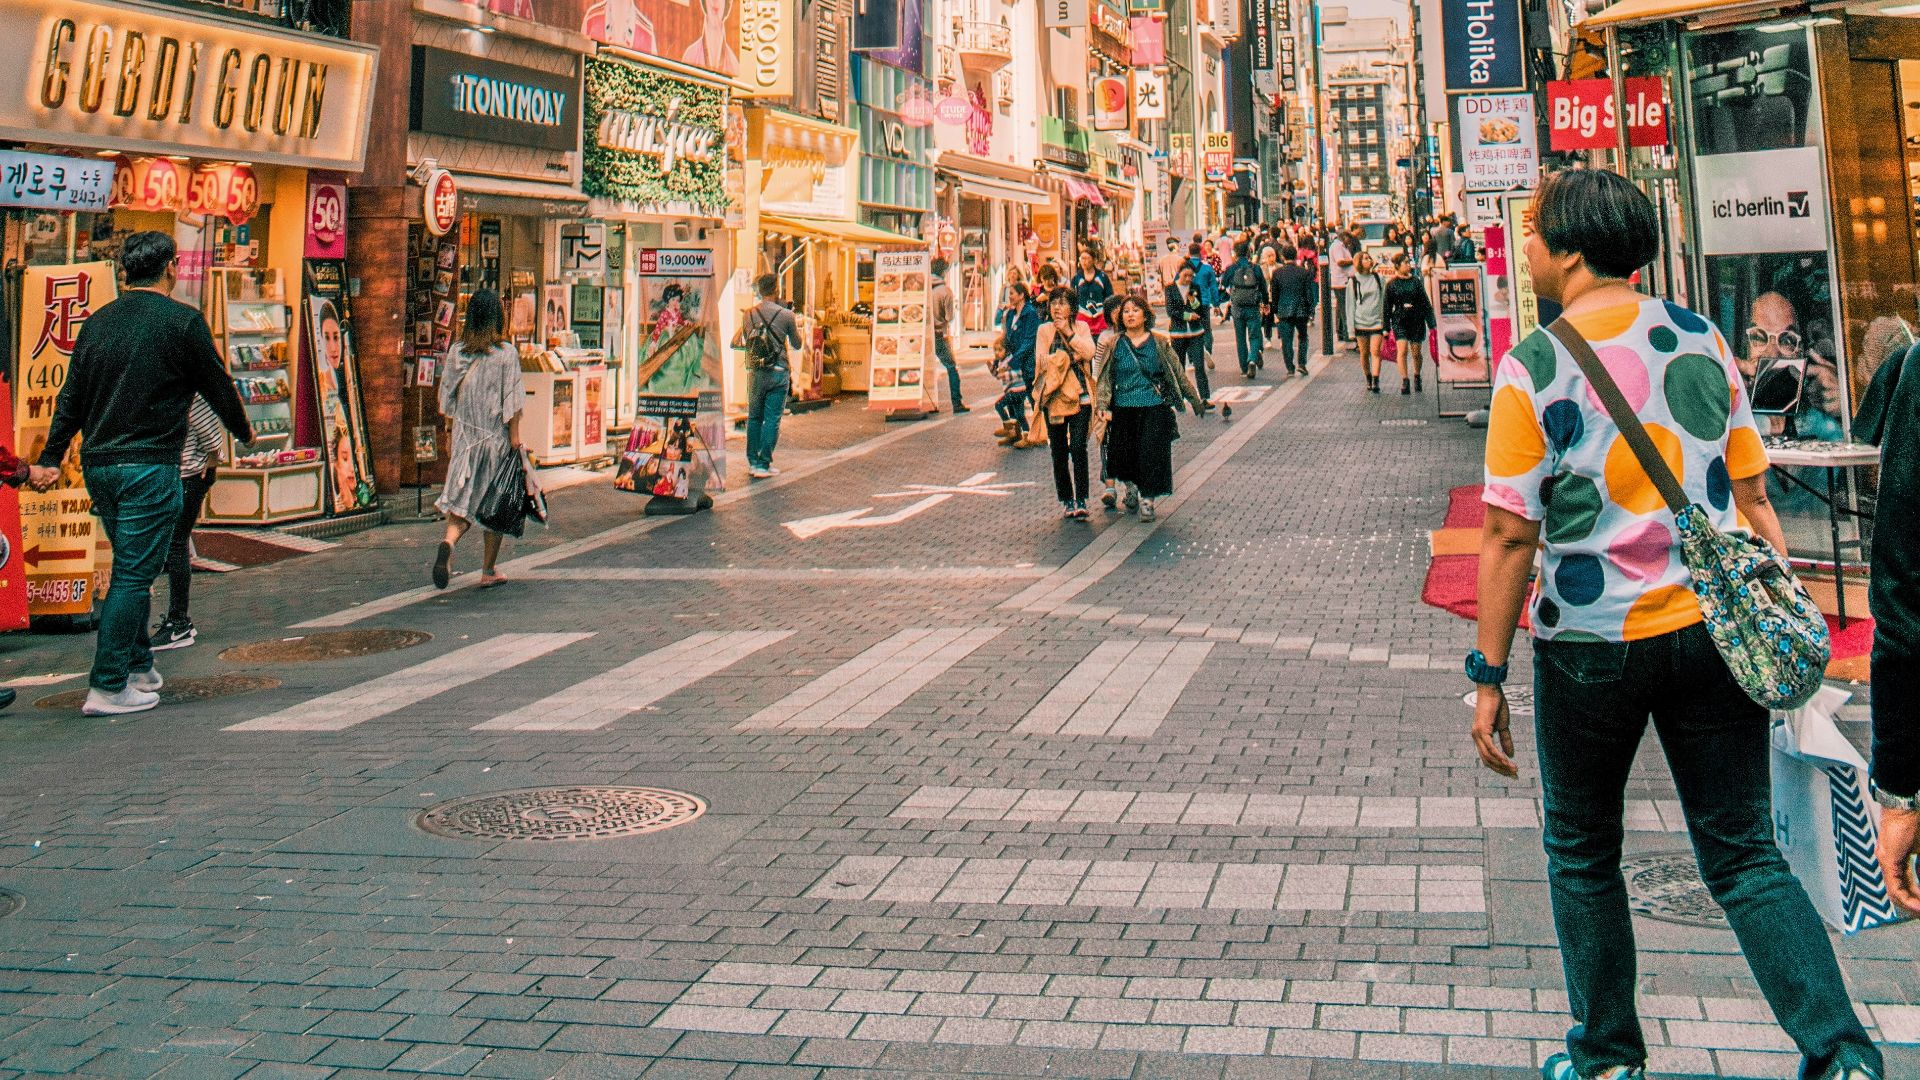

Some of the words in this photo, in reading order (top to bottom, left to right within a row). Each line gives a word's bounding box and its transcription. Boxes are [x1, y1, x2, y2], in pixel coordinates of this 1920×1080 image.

[1258, 36, 1267, 67] COFFEE
[458, 74, 566, 126] TONYMOLY
[1138, 82, 1160, 107] 光
[1466, 98, 1492, 114] DD
[1554, 95, 1598, 138] Big
[1208, 136, 1229, 147] BIG
[1207, 153, 1229, 165] MART
[1712, 200, 1732, 218] ic!
[1736, 196, 1785, 217] berlin
[72, 580, 87, 601] 3F
